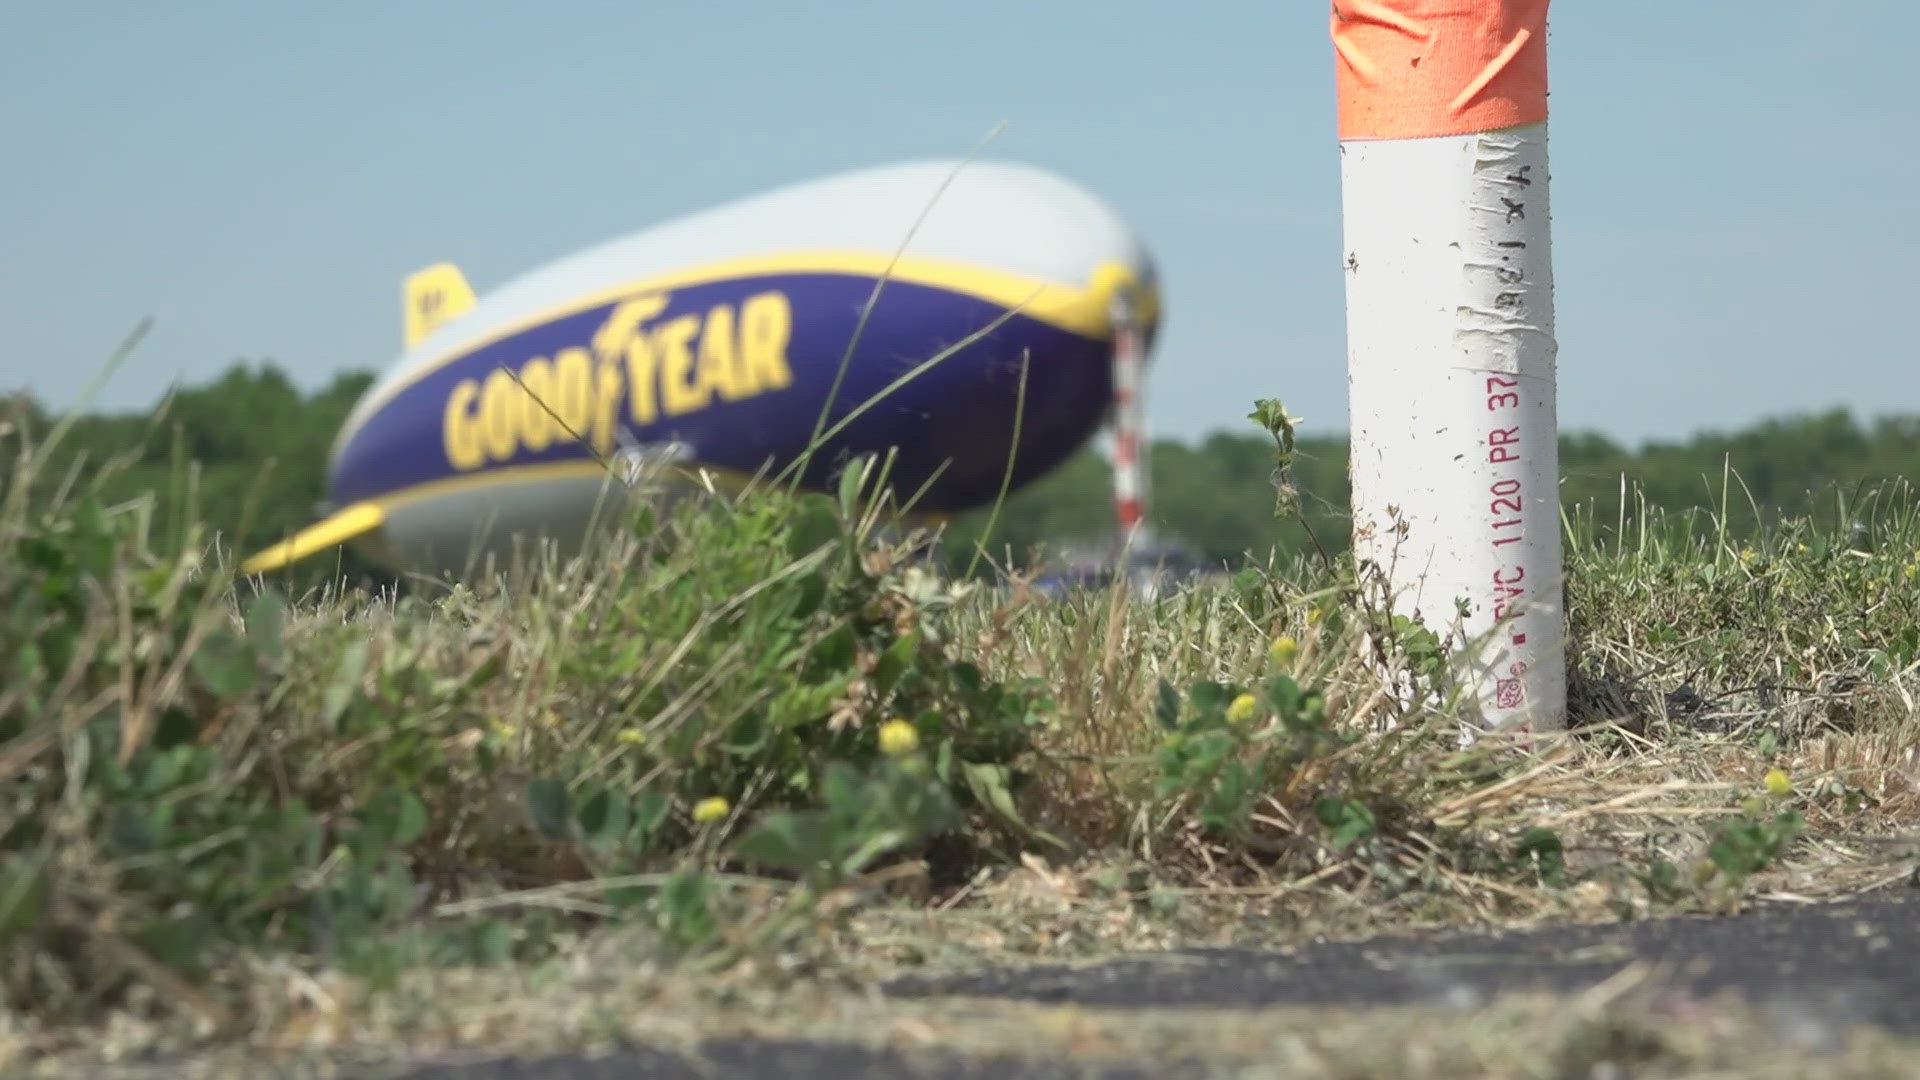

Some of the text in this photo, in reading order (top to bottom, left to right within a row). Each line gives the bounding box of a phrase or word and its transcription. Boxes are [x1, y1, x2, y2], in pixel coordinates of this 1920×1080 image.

[443, 290, 794, 470] GOODYEAR
[1488, 425, 1521, 464] PR
[1490, 478, 1523, 547] 1120
[1493, 565, 1525, 625] PVC
